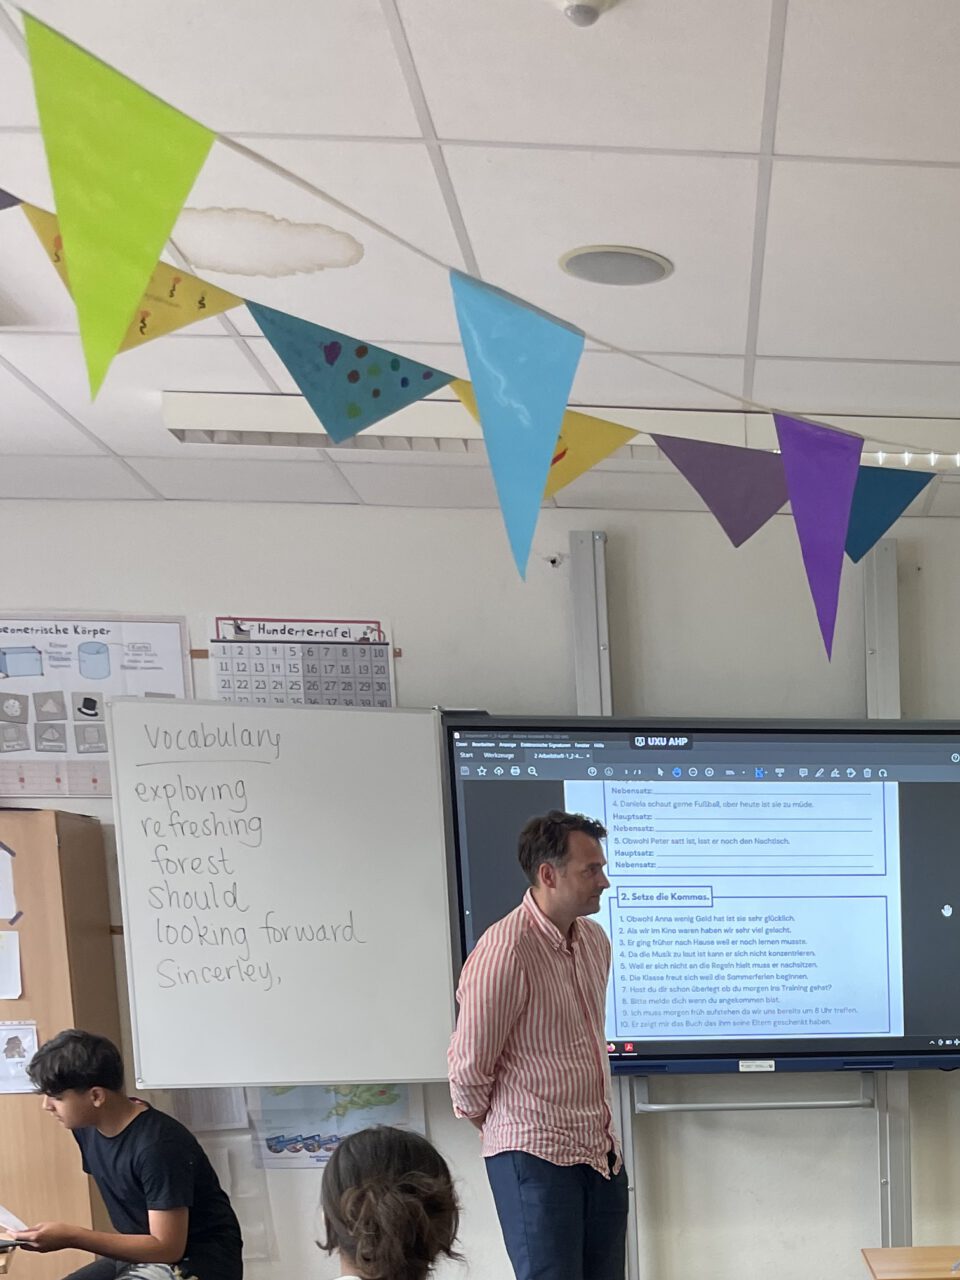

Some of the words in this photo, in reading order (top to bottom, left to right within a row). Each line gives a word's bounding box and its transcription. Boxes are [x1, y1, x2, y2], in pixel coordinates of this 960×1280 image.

[0, 625, 69, 635] eometrische
[73, 625, 111, 638] Körper
[258, 623, 351, 639] Hundertertafel
[222, 646, 226, 655] 1
[238, 646, 243, 655] 2
[255, 646, 261, 655] 3
[272, 647, 277, 655] 4
[290, 647, 296, 657] 5
[307, 648, 313, 656] 6
[323, 648, 330, 657] 7
[342, 648, 348, 657] 8
[360, 648, 366, 657] 9
[374, 648, 383, 658] 10
[220, 662, 229, 671] 11
[237, 663, 247, 672] 12
[255, 663, 264, 672] 13
[271, 664, 280, 672] 14
[289, 663, 299, 673] 15
[307, 664, 317, 673] 16
[324, 665, 335, 673] 17
[341, 665, 350, 674] 18
[359, 665, 369, 674] 19
[375, 666, 385, 675] 20
[221, 680, 231, 689] 21
[237, 680, 248, 689] 22
[255, 680, 266, 689] 23
[272, 680, 283, 689] 24
[289, 681, 300, 690] 25
[307, 681, 318, 690] 26
[324, 681, 336, 690] 27
[341, 681, 352, 691] 28
[359, 682, 370, 691] 29
[376, 682, 386, 692] 30
[144, 723, 280, 759] Vocabulary
[648, 737, 667, 745] UXU
[669, 738, 688, 746] AHP
[135, 774, 247, 813] exploring
[141, 810, 262, 847] refreshing
[152, 844, 234, 875] forest
[149, 880, 249, 912] should
[621, 893, 630, 901] 2.
[631, 893, 655, 901] Setze
[655, 893, 669, 901] die
[670, 893, 710, 901] Kommas.
[157, 916, 250, 961] looking
[259, 910, 367, 944] forward
[157, 959, 281, 991] Sincerley,
